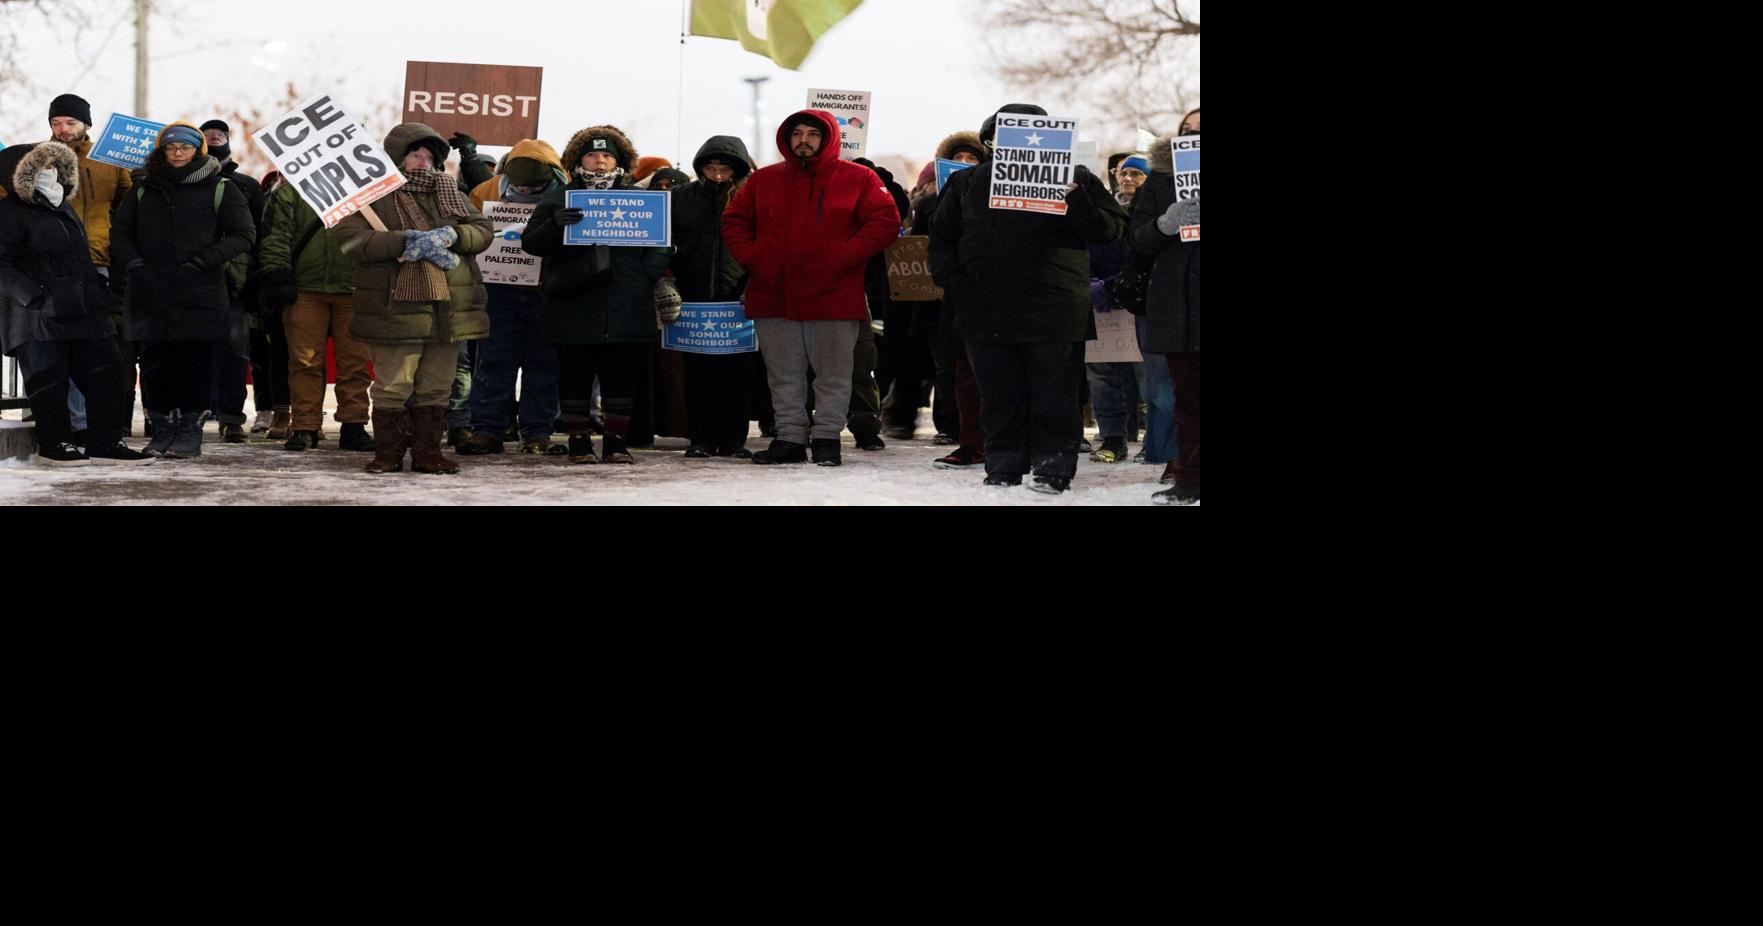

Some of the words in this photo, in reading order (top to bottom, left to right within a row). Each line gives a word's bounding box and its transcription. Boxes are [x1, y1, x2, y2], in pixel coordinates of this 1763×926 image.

[408, 90, 537, 117] RESIST
[811, 101, 867, 111] IMMIGRANTS!
[260, 95, 345, 158] ICE
[998, 117, 1029, 127] ICE
[1033, 119, 1075, 129] OUT!
[126, 124, 141, 134] WE
[143, 128, 158, 137] STA
[112, 132, 138, 145] WITH
[123, 145, 149, 156] SOM
[284, 143, 323, 175] OUT
[326, 123, 357, 149] OF
[1173, 140, 1200, 150] ICE
[107, 150, 145, 165] NEIGHB
[995, 148, 1035, 163] STAND
[1040, 150, 1071, 165] WITH
[298, 143, 387, 213] MPLS
[994, 163, 1069, 185] SOMALI
[1176, 172, 1200, 187] STA
[993, 183, 1065, 201] NEIGHBORS
[588, 198, 606, 206] WE
[609, 198, 645, 206] STAND
[492, 206, 521, 215] HANDS
[629, 211, 653, 219] OUR
[596, 221, 639, 229] SOMALI
[582, 229, 649, 238] NEIGHBORS
[1182, 229, 1200, 238] FR
[500, 246, 522, 254] FREE
[484, 255, 535, 266] PALESTINE!
[888, 261, 932, 276] ABOL
[677, 337, 738, 346] NEIGHBORS
